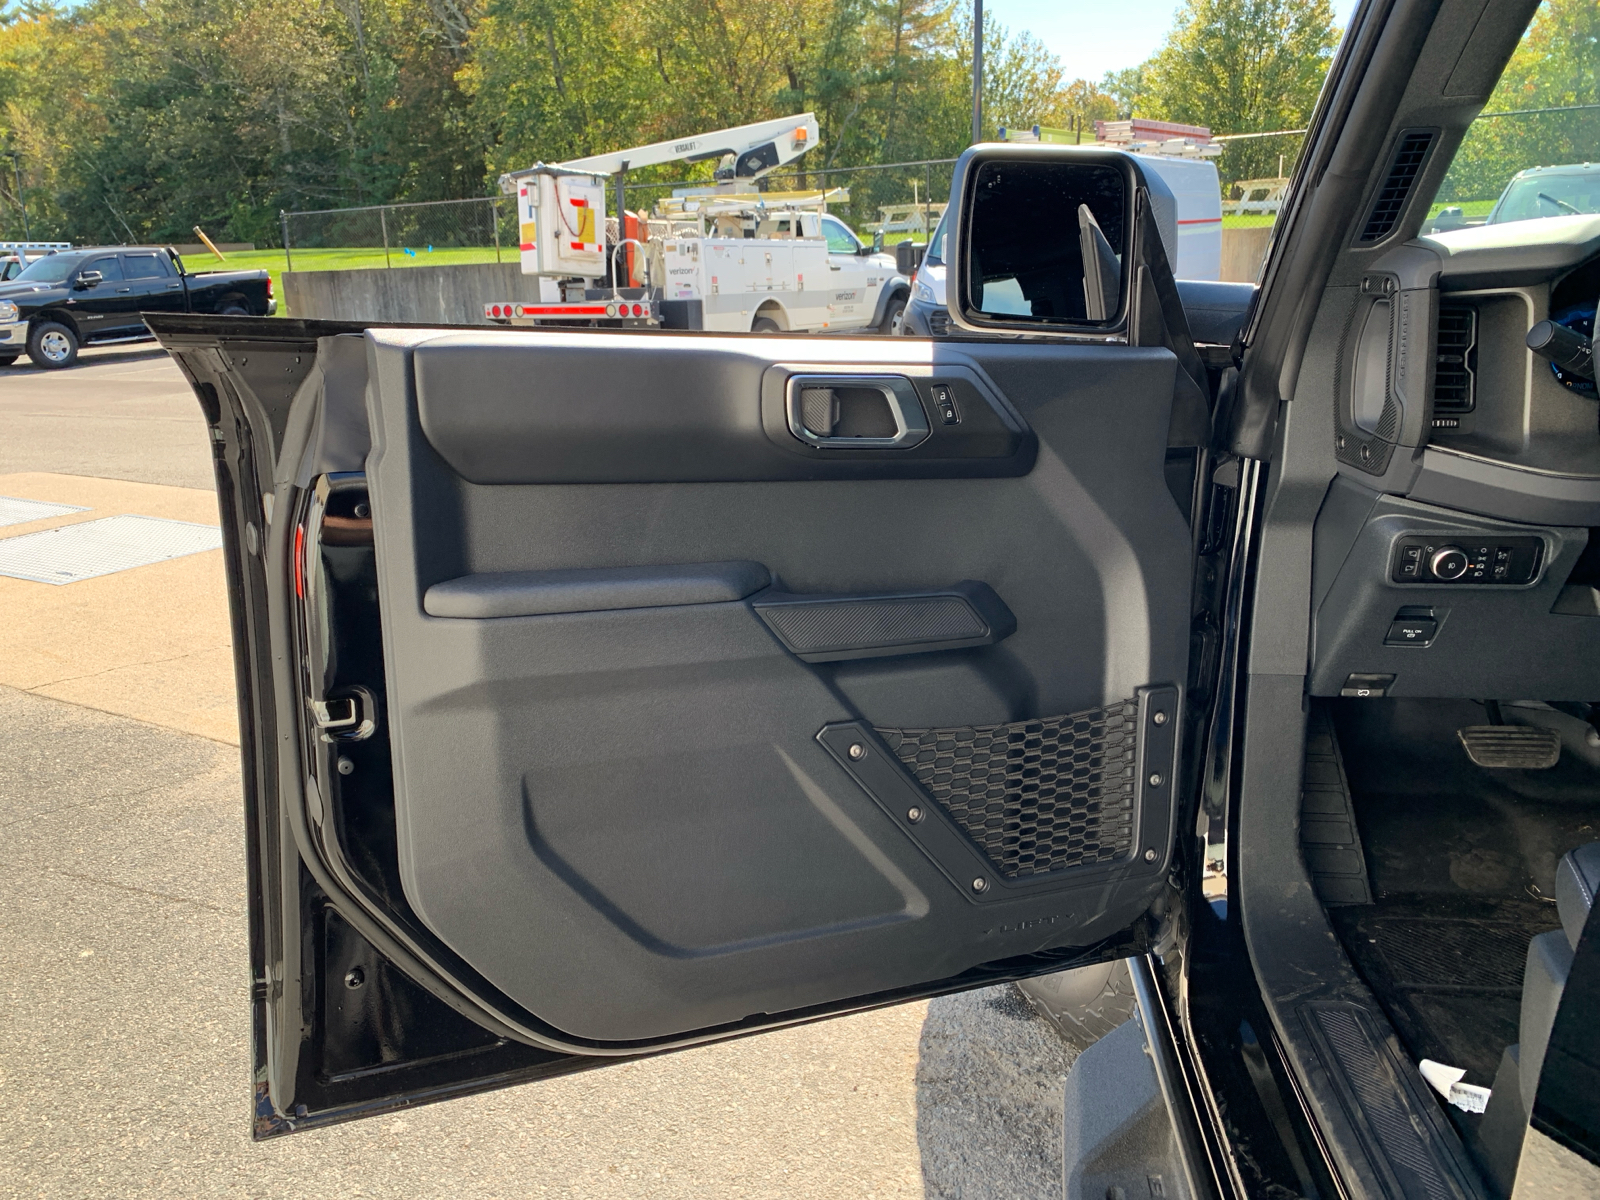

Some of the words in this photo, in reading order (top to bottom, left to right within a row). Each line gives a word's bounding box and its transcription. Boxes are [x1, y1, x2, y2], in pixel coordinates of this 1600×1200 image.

[674, 141, 696, 154] VERSALIFT
[669, 266, 694, 275] verizon
[835, 290, 856, 301] verizon
